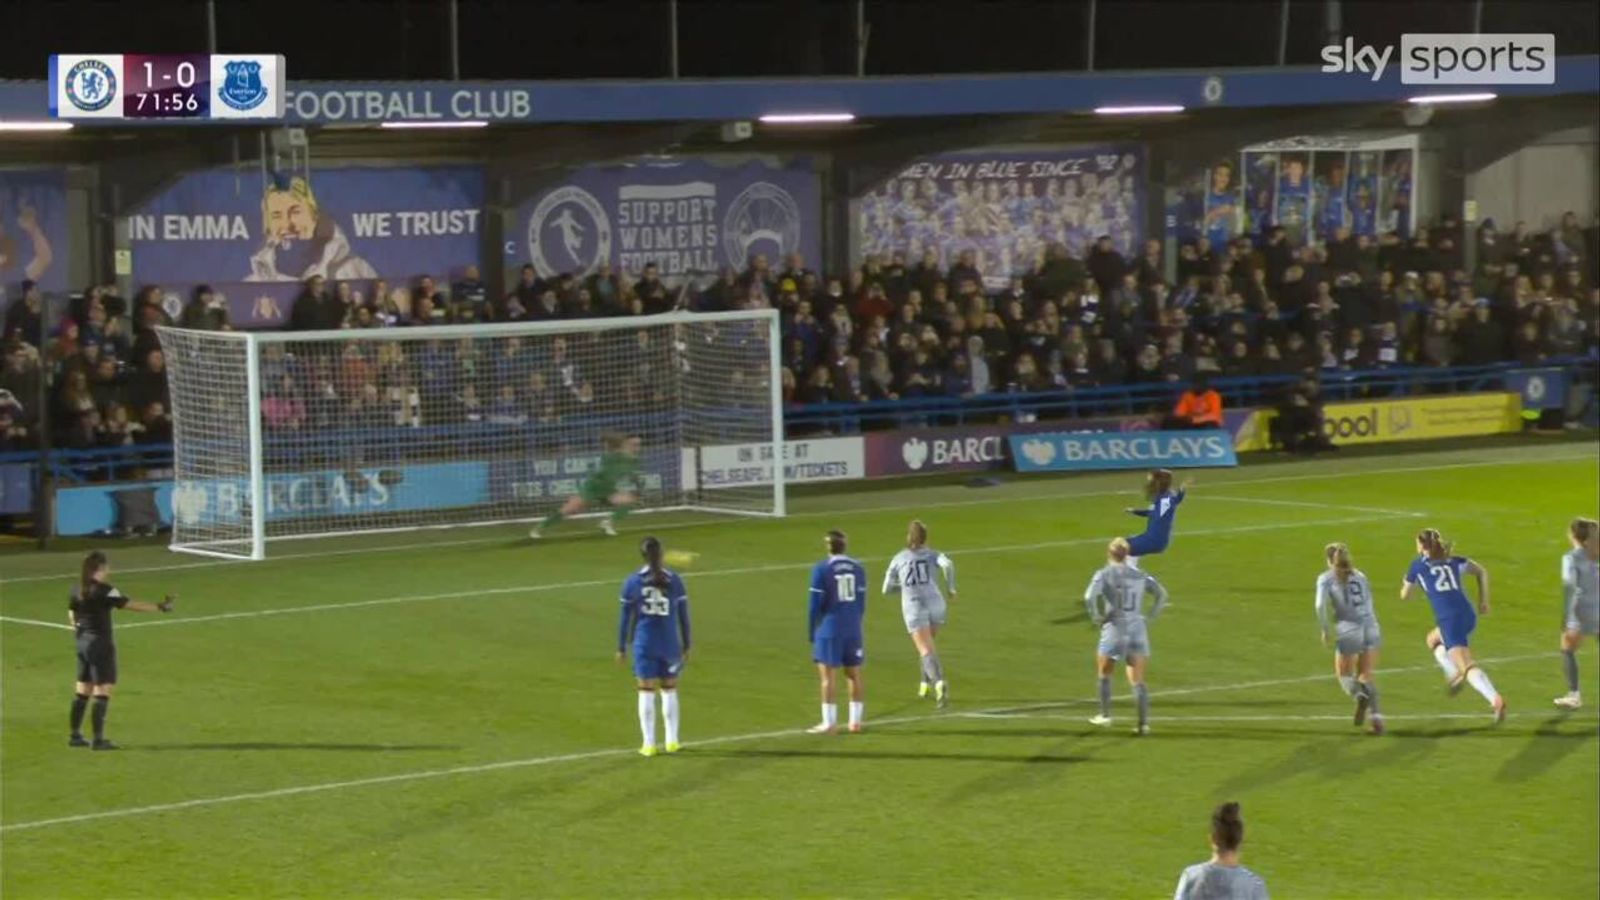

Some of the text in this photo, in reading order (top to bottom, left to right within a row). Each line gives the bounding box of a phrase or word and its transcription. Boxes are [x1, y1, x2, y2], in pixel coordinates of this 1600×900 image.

[451, 90, 530, 118] CLUB
[944, 161, 974, 179] IN
[975, 160, 1026, 179] BLUE
[1028, 157, 1089, 178] SINCE
[128, 209, 481, 241] IN EMMA WE TRUST
[618, 198, 717, 225] SUPPORT
[619, 224, 717, 250] WOMENS
[619, 249, 719, 276] FOOTBALL
[760, 444, 789, 461] SAE
[1065, 435, 1227, 463] BARCLAYS
[216, 470, 389, 516] BRCLAS
[905, 559, 930, 586] 20
[1430, 563, 1459, 592] 21
[833, 573, 856, 602] 10
